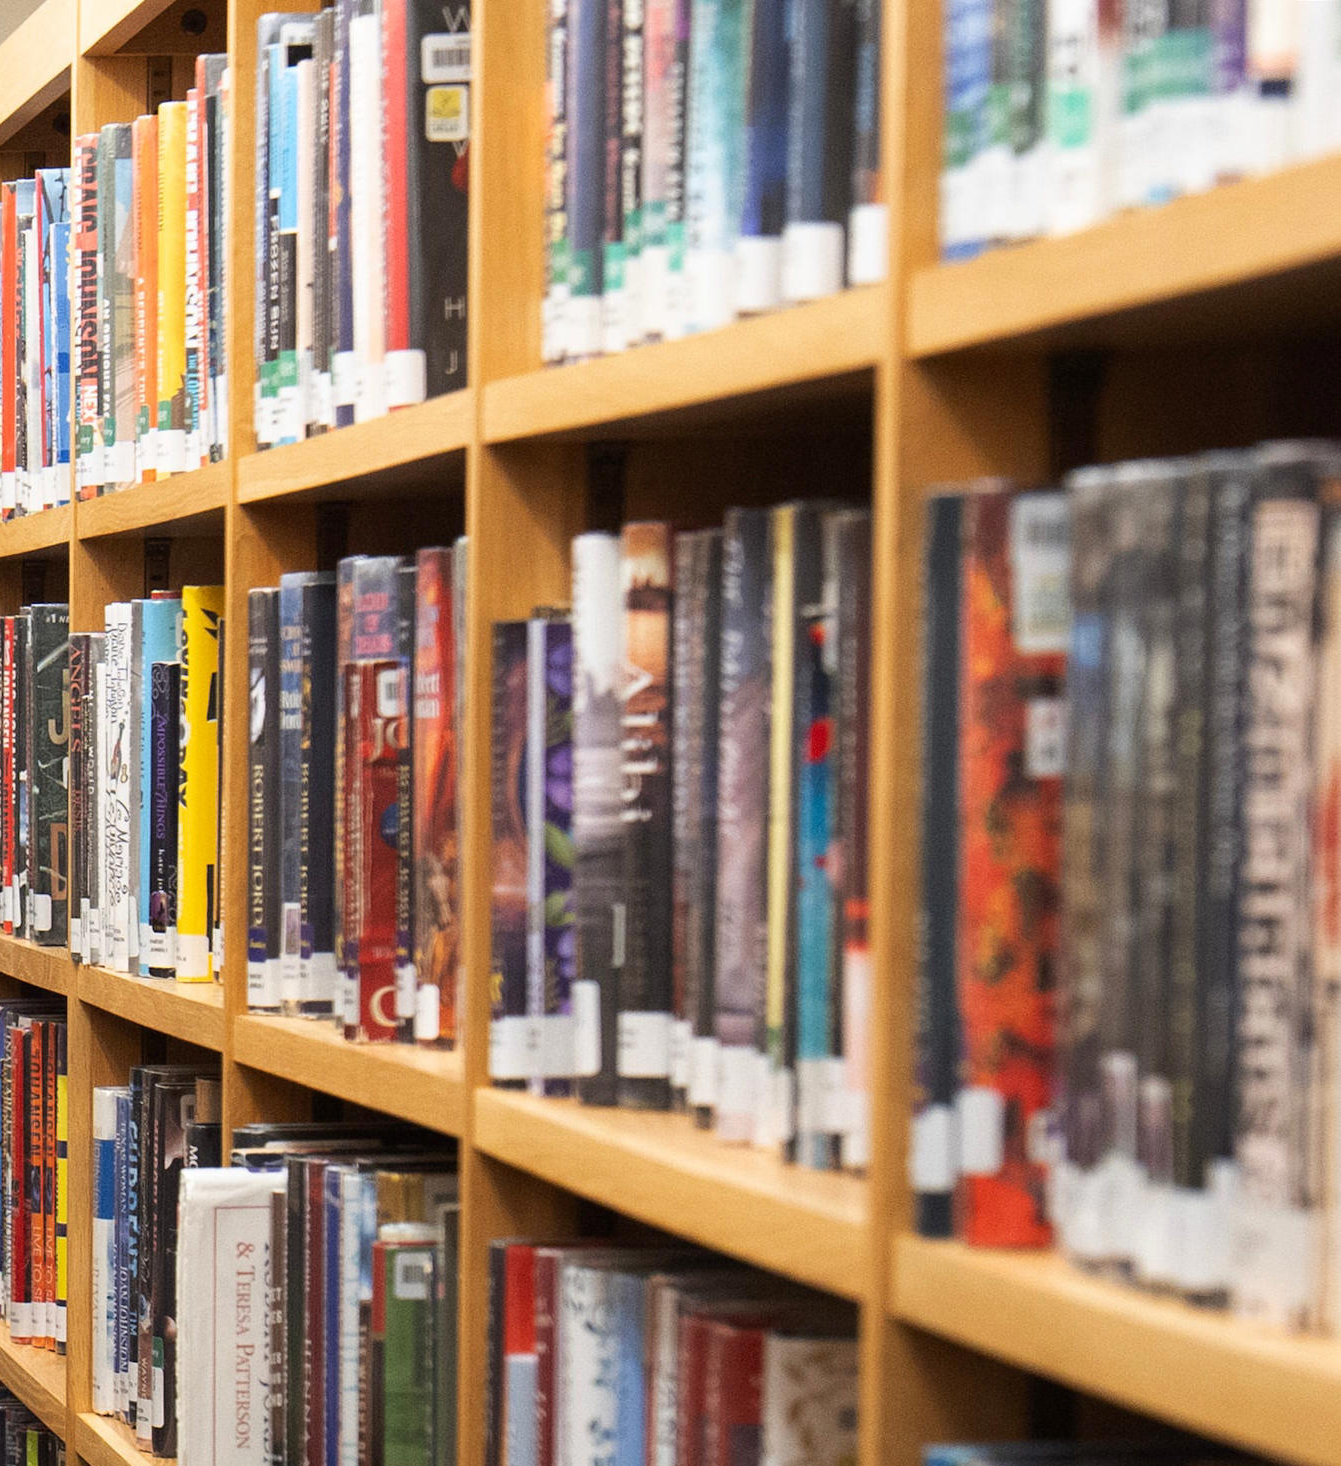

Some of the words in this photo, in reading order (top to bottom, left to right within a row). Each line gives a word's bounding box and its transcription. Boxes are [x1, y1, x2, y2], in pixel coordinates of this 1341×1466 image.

[79, 146, 98, 233] CRAIG
[79, 251, 98, 382] JOHNSON
[69, 648, 82, 753] ANGELS
[252, 764, 264, 855] ROBERT
[252, 864, 264, 926] JORD
[119, 1121, 128, 1163] TEXAS
[119, 1165, 128, 1213] WOMAN
[118, 1265, 128, 1301] JOAN
[236, 1240, 254, 1258] &
[129, 1310, 137, 1335] TIM
[235, 1264, 257, 1336] TERESA
[118, 1303, 128, 1374] JOHNSTON
[235, 1343, 256, 1450] PATTERSON
